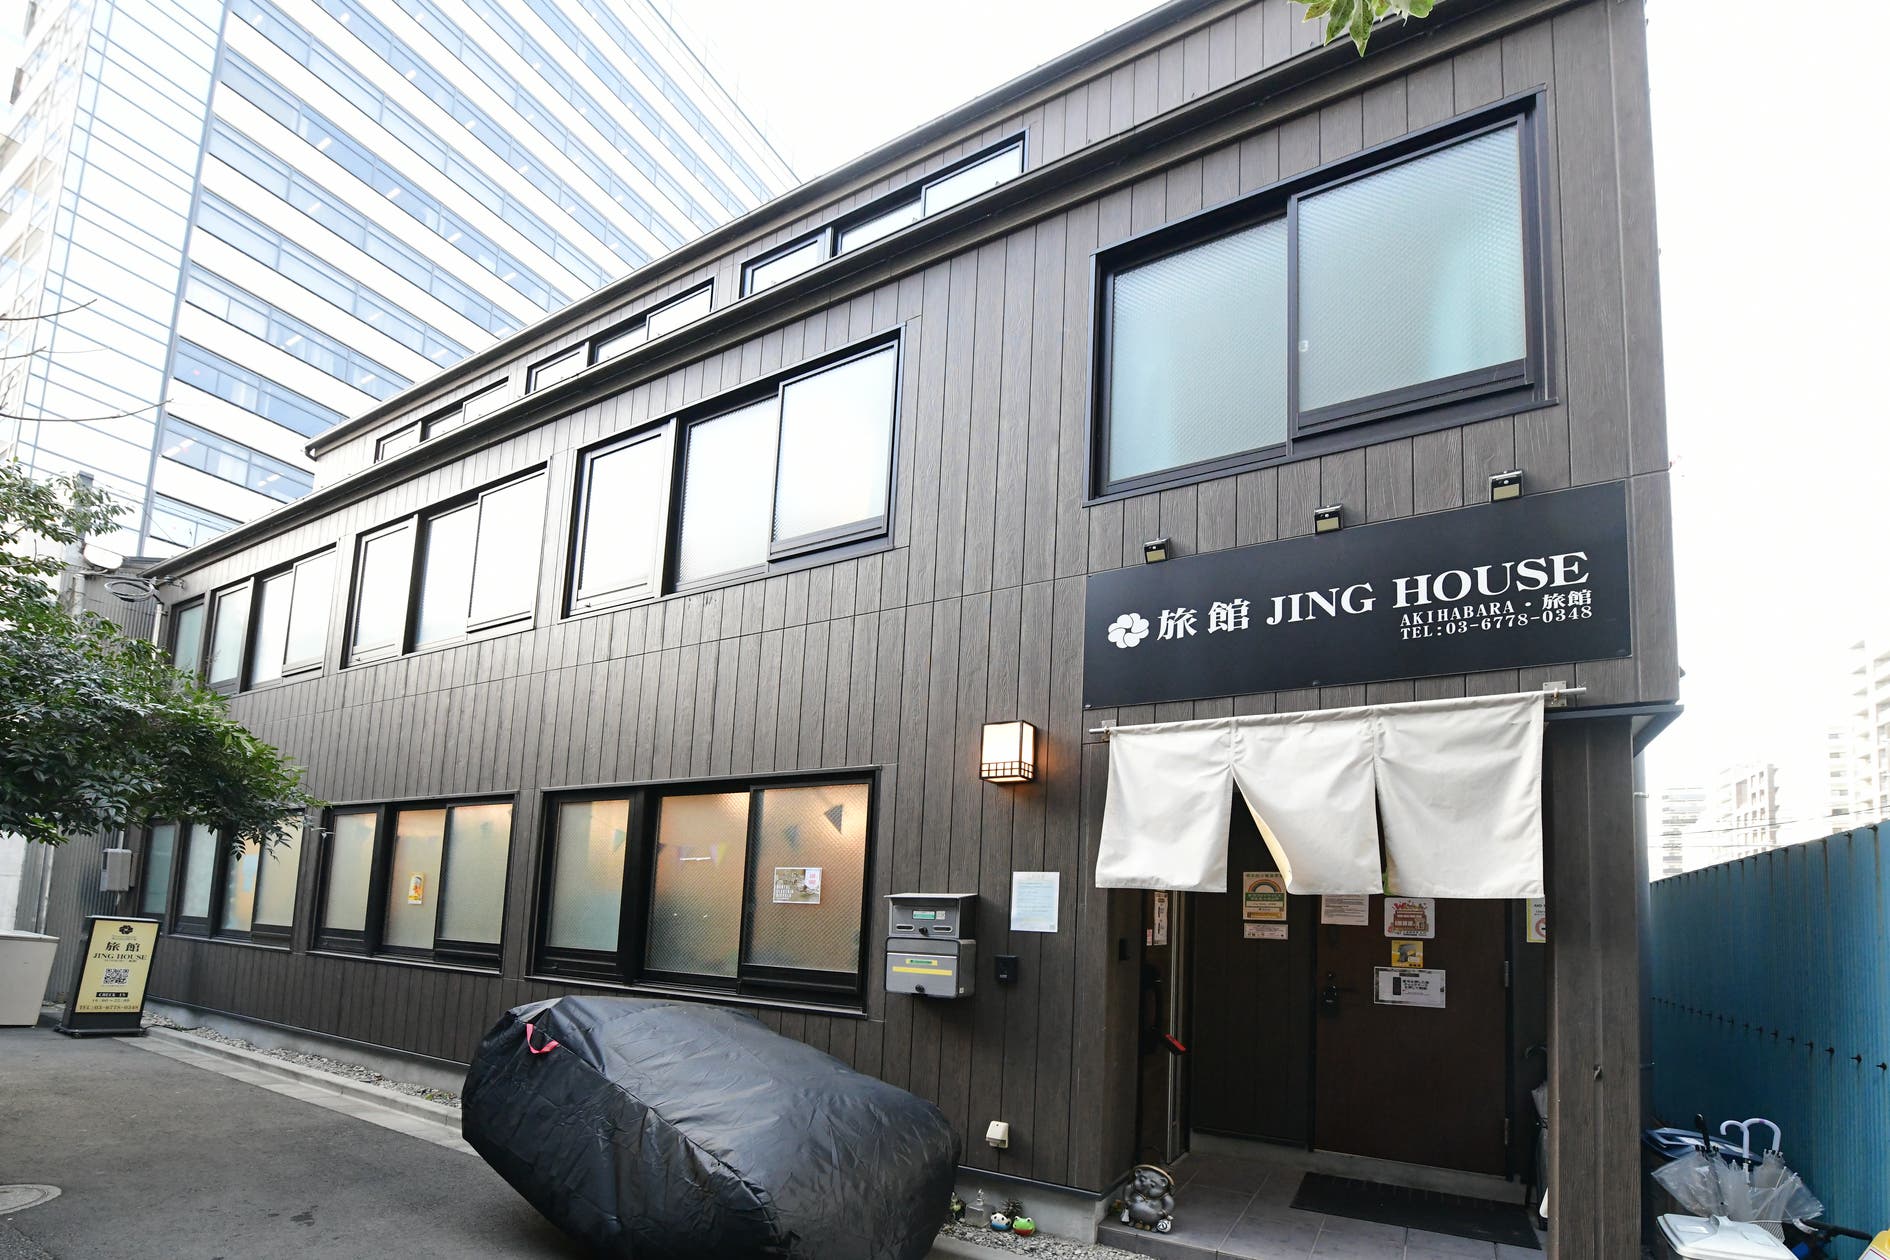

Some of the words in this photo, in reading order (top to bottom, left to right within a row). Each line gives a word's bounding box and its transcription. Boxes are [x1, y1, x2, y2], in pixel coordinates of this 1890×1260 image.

[1157, 598, 1251, 641] 旅館
[1266, 582, 1377, 626] JING
[1392, 551, 1589, 609] HOUSE
[1400, 600, 1515, 627] AKIHABARA
[1541, 588, 1592, 610] 旅館
[1400, 605, 1593, 641] TEL:03-6778-0348
